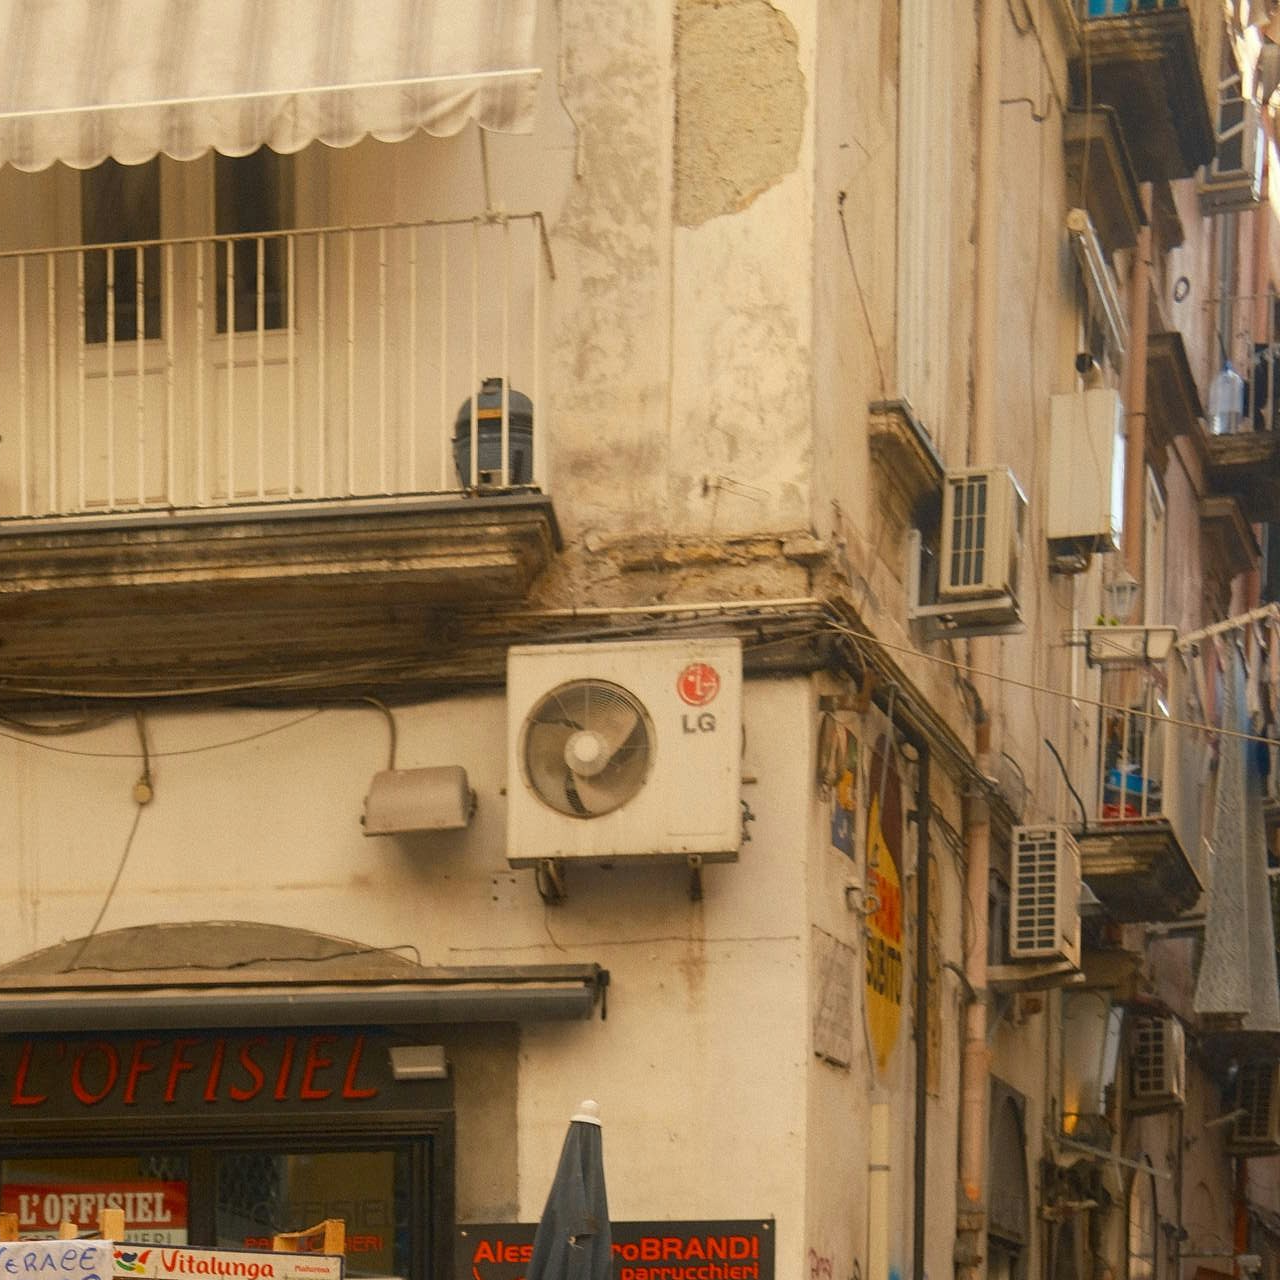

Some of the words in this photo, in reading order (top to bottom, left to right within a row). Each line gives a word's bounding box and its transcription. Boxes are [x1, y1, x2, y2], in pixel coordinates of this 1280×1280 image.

[682, 713, 716, 734] LG
[11, 1035, 380, 1105] L'OFFISIEL
[18, 1192, 172, 1226] L'OFFISIEL
[162, 1250, 274, 1280] Vitalunga
